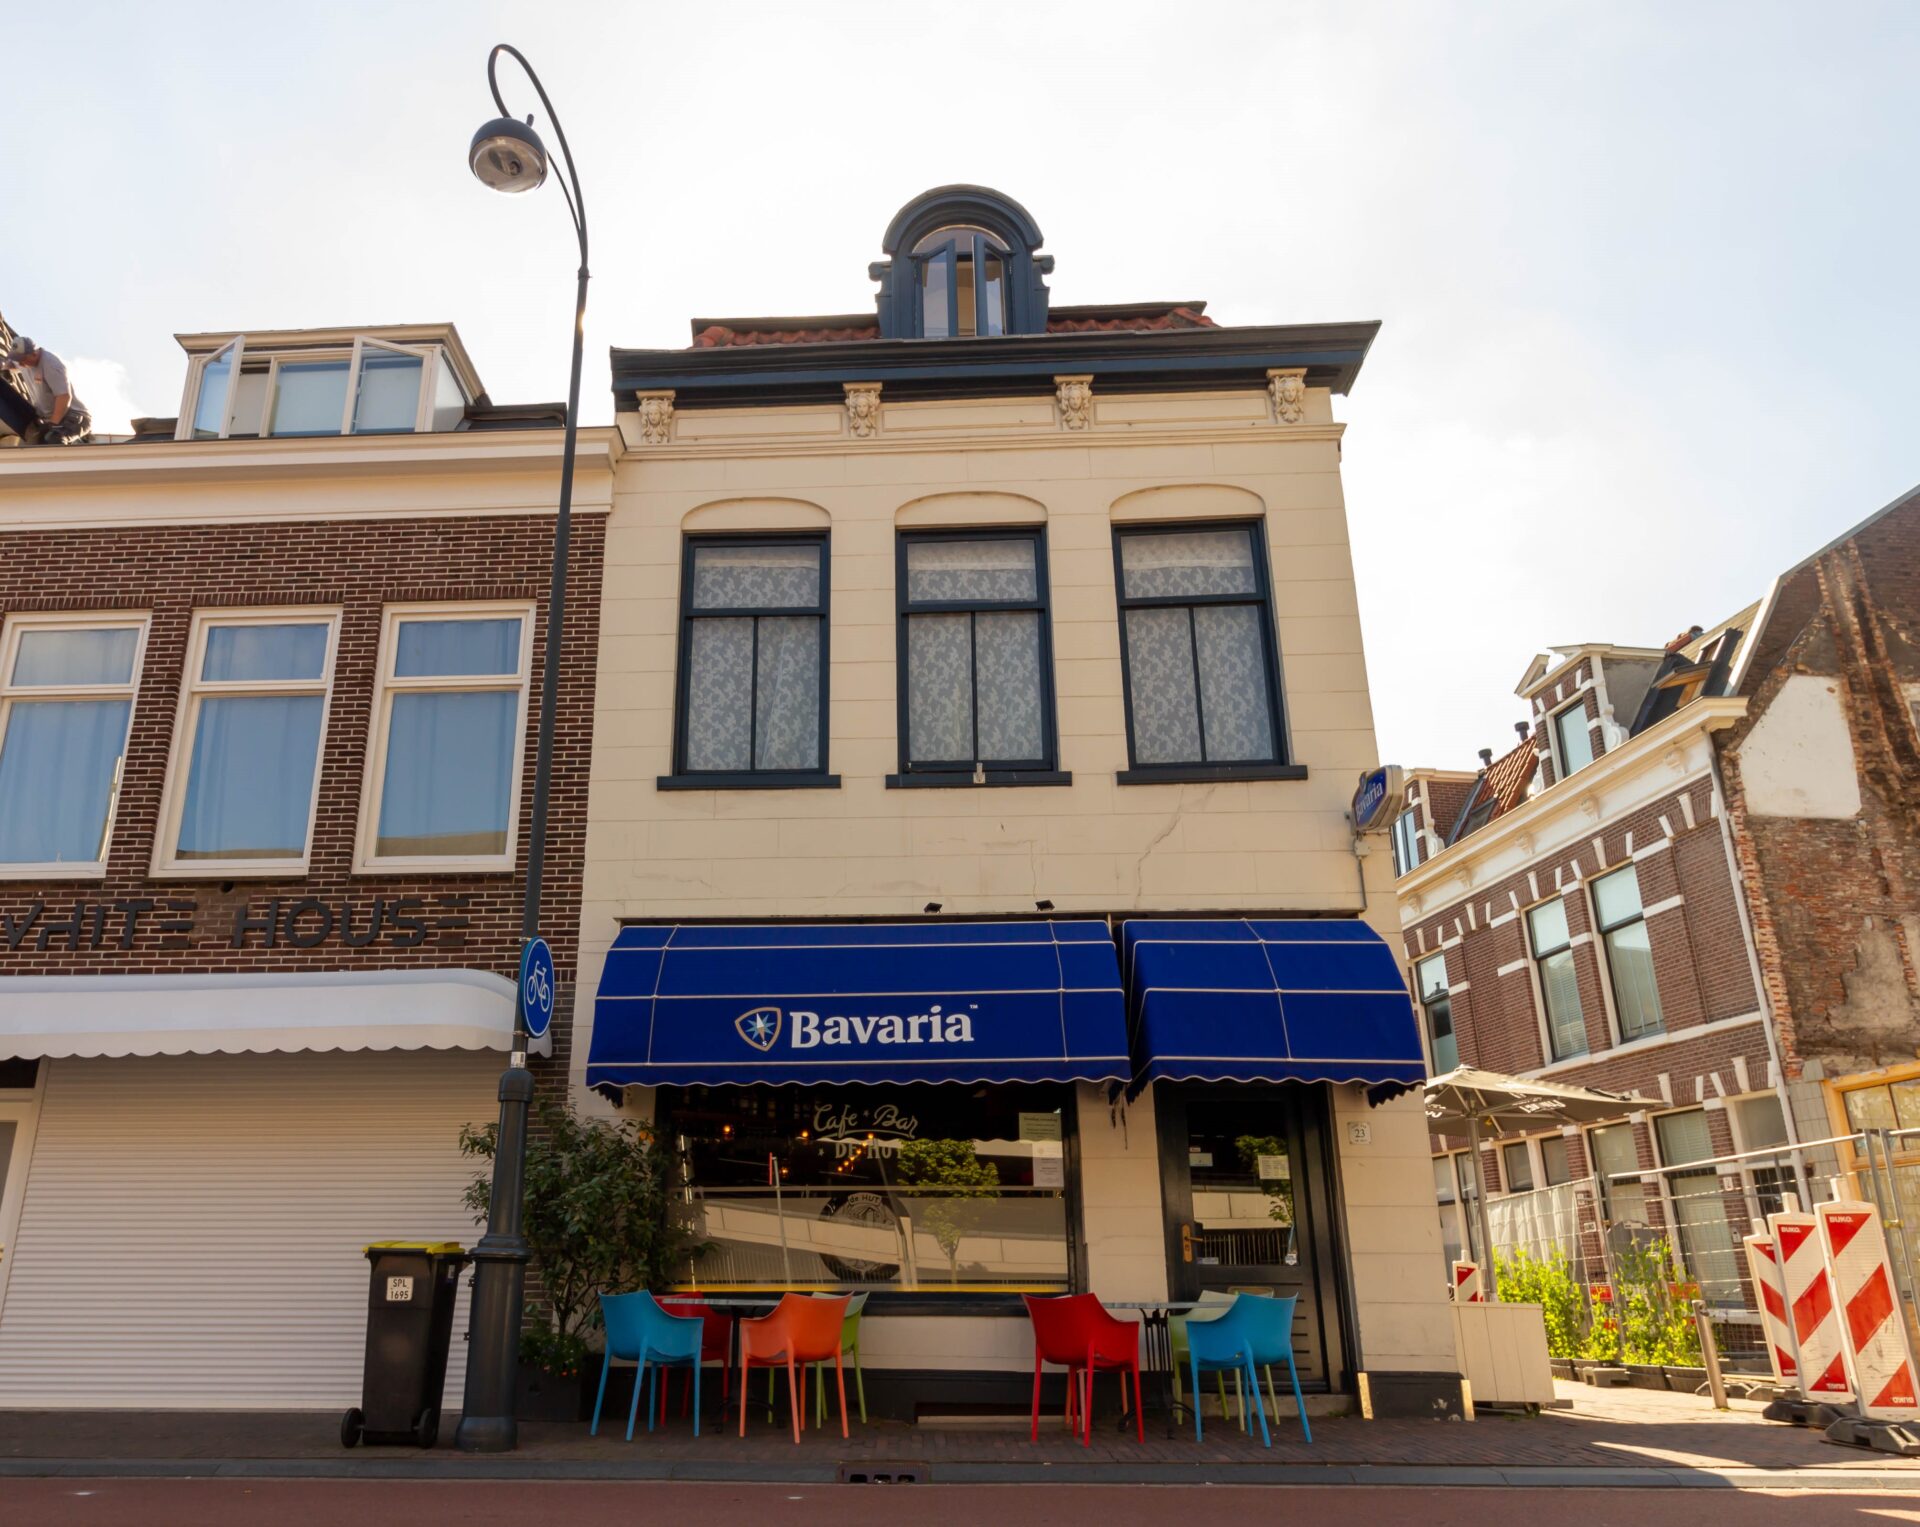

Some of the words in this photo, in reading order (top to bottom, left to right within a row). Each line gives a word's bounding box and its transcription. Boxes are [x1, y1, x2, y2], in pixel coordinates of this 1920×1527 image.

[231, 898, 470, 950] HOUSE
[789, 1005, 975, 1049] Bavaria
[872, 1103, 919, 1139] Bar
[1354, 1128, 1366, 1138] 23
[861, 1194, 880, 1204] HUT
[392, 1278, 407, 1288] SPL
[390, 1290, 409, 1299] 1695
